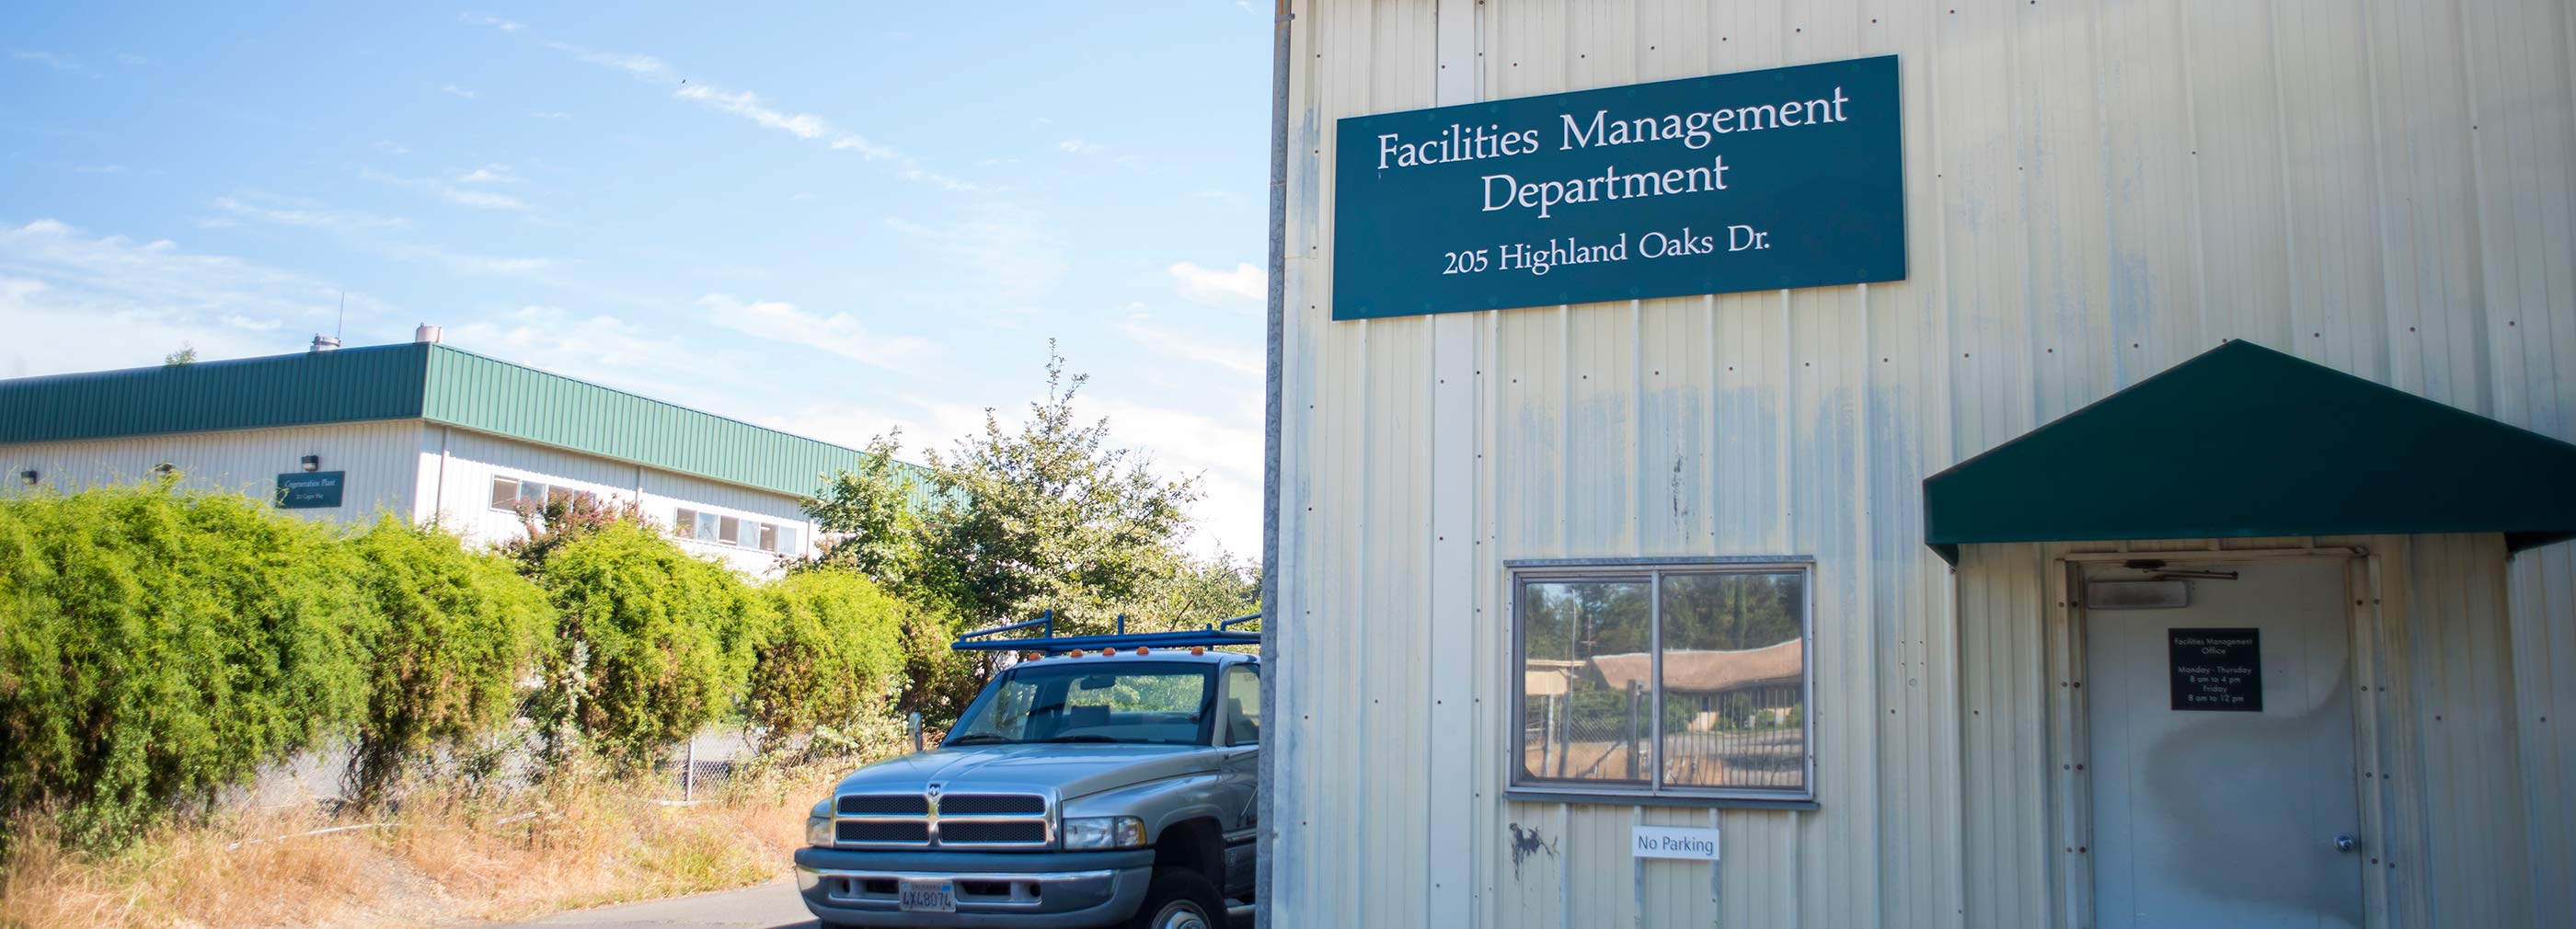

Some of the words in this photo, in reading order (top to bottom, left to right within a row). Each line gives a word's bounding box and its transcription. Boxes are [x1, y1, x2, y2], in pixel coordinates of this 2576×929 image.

[1377, 123, 1539, 169] Facilities
[1559, 86, 1848, 151] Management
[1481, 155, 1729, 219] Department
[1443, 249, 1488, 275] 205
[1499, 233, 1627, 275] Highland
[1639, 227, 1714, 258] Oaks
[1728, 224, 1770, 252] Dr.
[321, 478, 336, 487] Plant
[2206, 637, 2253, 647] Management
[2178, 666, 2210, 674] Monday
[2216, 666, 2252, 676] Thursday
[2202, 685, 2227, 694] Friday
[2188, 694, 2194, 702] 8
[1639, 835, 1658, 850] No
[1662, 836, 1714, 855] Parking
[903, 891, 951, 907] 4X48074
